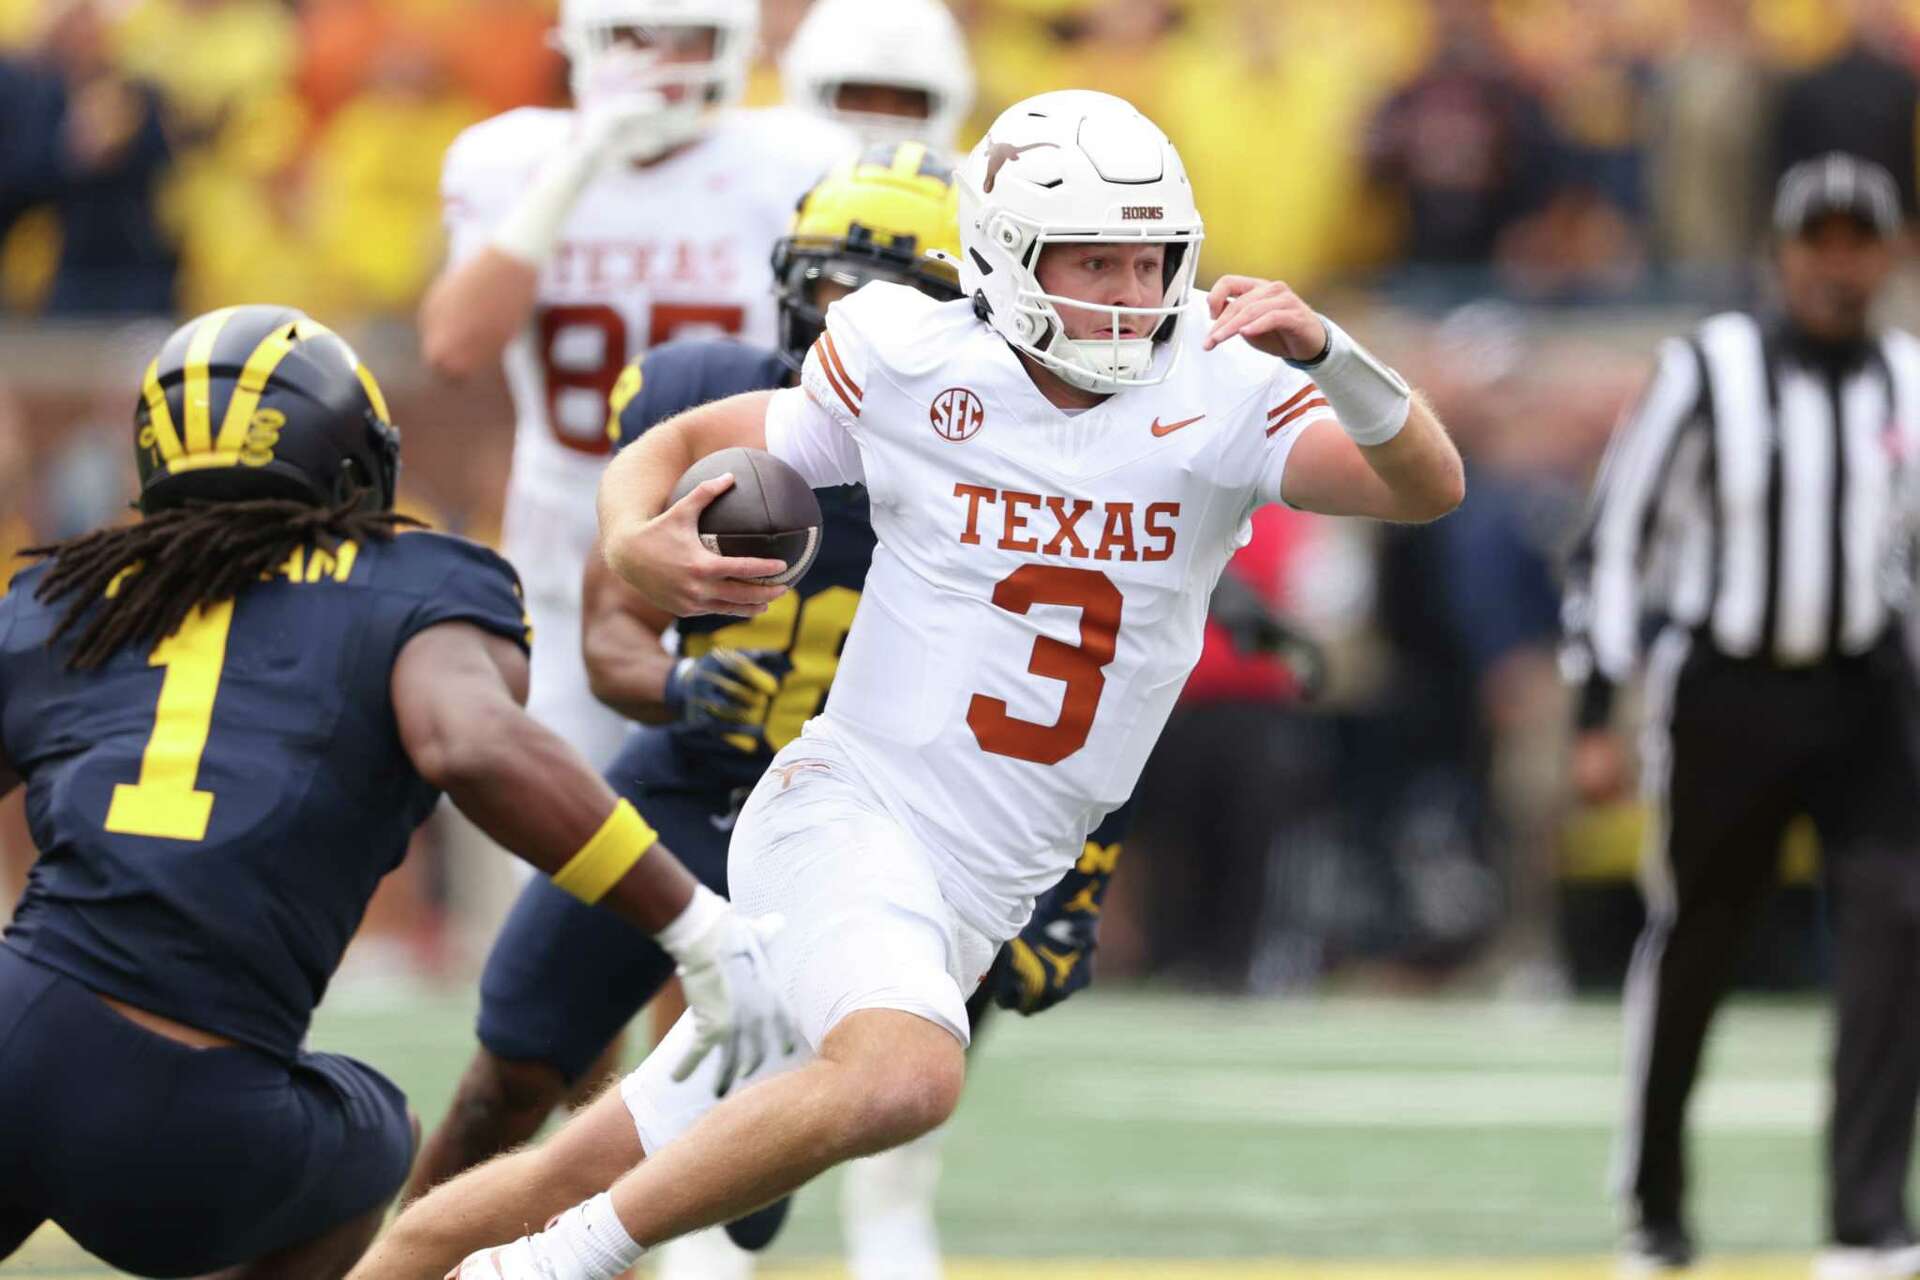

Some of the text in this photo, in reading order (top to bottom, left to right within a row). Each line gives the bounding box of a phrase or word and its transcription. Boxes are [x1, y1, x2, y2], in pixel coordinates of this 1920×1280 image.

[1121, 206, 1164, 220] HORNS
[552, 239, 742, 286] TEXAS
[931, 388, 983, 440] SEC
[953, 482, 1182, 562] TEXAS
[966, 563, 1124, 766] 3
[104, 594, 237, 841] 1
